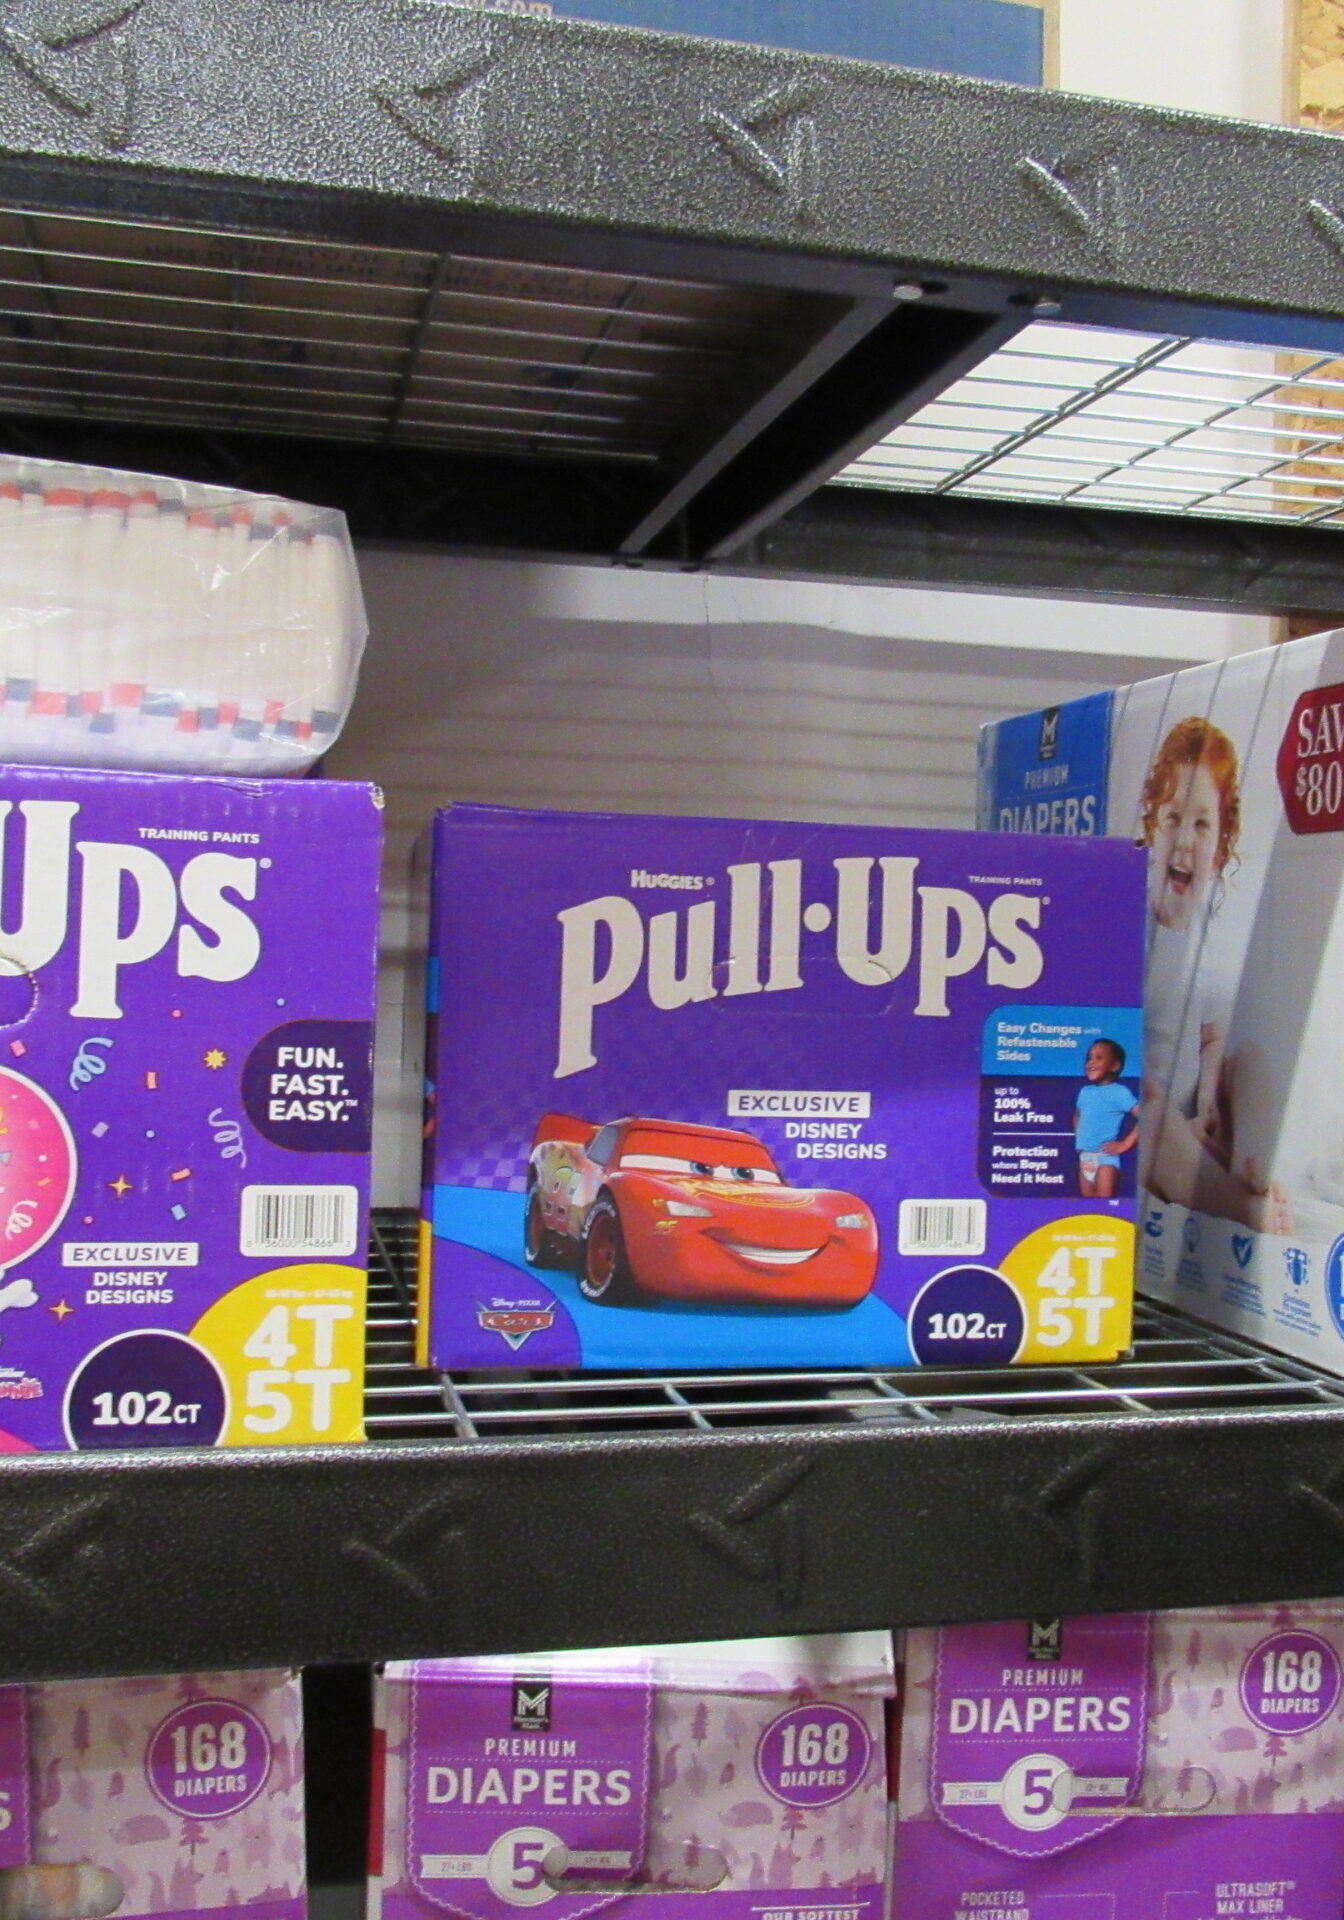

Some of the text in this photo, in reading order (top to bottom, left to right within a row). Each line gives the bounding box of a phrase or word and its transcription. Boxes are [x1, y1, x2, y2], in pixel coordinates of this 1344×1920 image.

[999, 795, 1096, 836] DIAPERS
[138, 828, 261, 844] TRAINING PANTS
[630, 869, 703, 890] HUGGIES
[968, 874, 1043, 887] TRAINING PANTS
[997, 1022, 1026, 1035] Easy
[1029, 1023, 1082, 1035] Changes
[997, 1037, 1077, 1048] Refastenable
[277, 1046, 344, 1069] FUN.
[996, 1050, 1031, 1061] Sides
[270, 1075, 349, 1097] FAST.
[994, 1087, 1020, 1096] up to
[737, 1095, 862, 1113] EXCLUSIVE
[994, 1098, 1031, 1109] 100%
[993, 1111, 1054, 1123] Leak Free
[784, 1122, 863, 1140] DISNEY
[796, 1143, 887, 1160] DESIGNS
[992, 1146, 1059, 1158] Protection
[1020, 1159, 1048, 1171] Boys
[991, 1172, 1065, 1184] Need it Most
[71, 1245, 189, 1262] EXCLUSIVE
[93, 1271, 168, 1287] DISNEY
[1036, 1246, 1119, 1297] 4T
[85, 1289, 174, 1305] DESIGNS
[1036, 1297, 1117, 1347] 5T
[243, 1304, 354, 1368] 4T
[243, 1368, 353, 1433] 5T
[1002, 1669, 1084, 1686] PREMIUM
[1262, 1650, 1322, 1694] 168
[949, 1696, 1131, 1734] DIAPERS
[1261, 1697, 1320, 1715] DIAPERS
[170, 1720, 248, 1773] 168
[484, 1738, 577, 1758] PREMIUM
[781, 1723, 850, 1767] 168
[173, 1773, 248, 1798] DIAPERS
[427, 1766, 632, 1806] DIAPERS
[780, 1769, 847, 1788] DIAPERS
[1023, 1769, 1053, 1815] 5
[511, 1842, 545, 1891] 5
[961, 1890, 1025, 1906] POCKETED
[1216, 1898, 1284, 1914] MAX LINER
